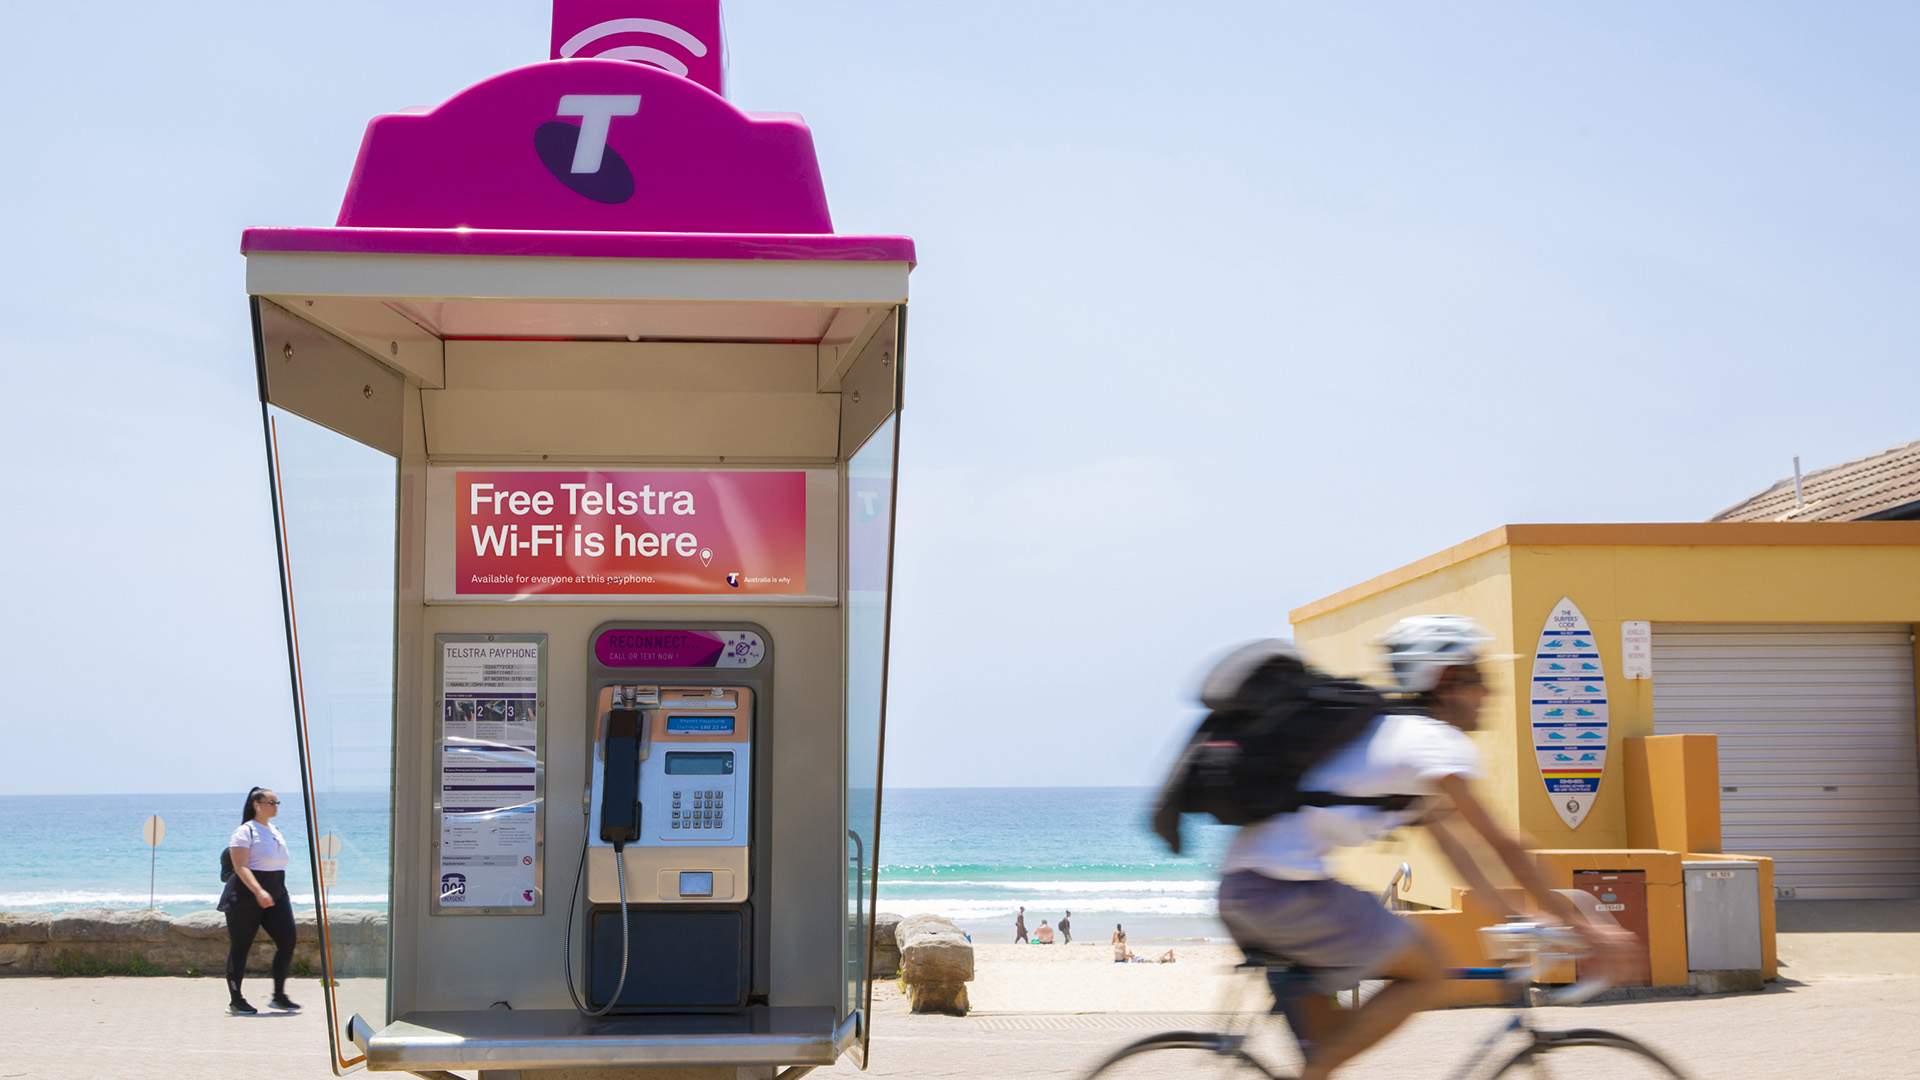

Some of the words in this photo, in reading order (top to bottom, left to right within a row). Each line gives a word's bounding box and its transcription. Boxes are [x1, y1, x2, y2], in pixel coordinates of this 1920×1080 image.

[556, 94, 642, 174] T
[470, 483, 554, 516] Free
[560, 483, 696, 516] Telstra
[471, 525, 563, 557] Wi-Fi
[574, 525, 605, 557] is
[615, 525, 698, 557] here
[471, 574, 513, 584] Available
[516, 574, 529, 584] for
[531, 576, 574, 586] everyone
[575, 575, 585, 584] at
[587, 574, 604, 584] this
[606, 574, 656, 586] payphone.
[778, 576, 792, 585] why
[446, 648, 487, 659] TELSTRA
[489, 648, 537, 659] PAYPHONE
[609, 652, 625, 660] CALL
[628, 652, 638, 660] OR
[640, 652, 656, 660] TEXT
[657, 652, 673, 660] NOW
[446, 705, 453, 717] 1
[477, 705, 484, 717] 2
[507, 705, 514, 717] 3
[441, 882, 466, 895] 000
